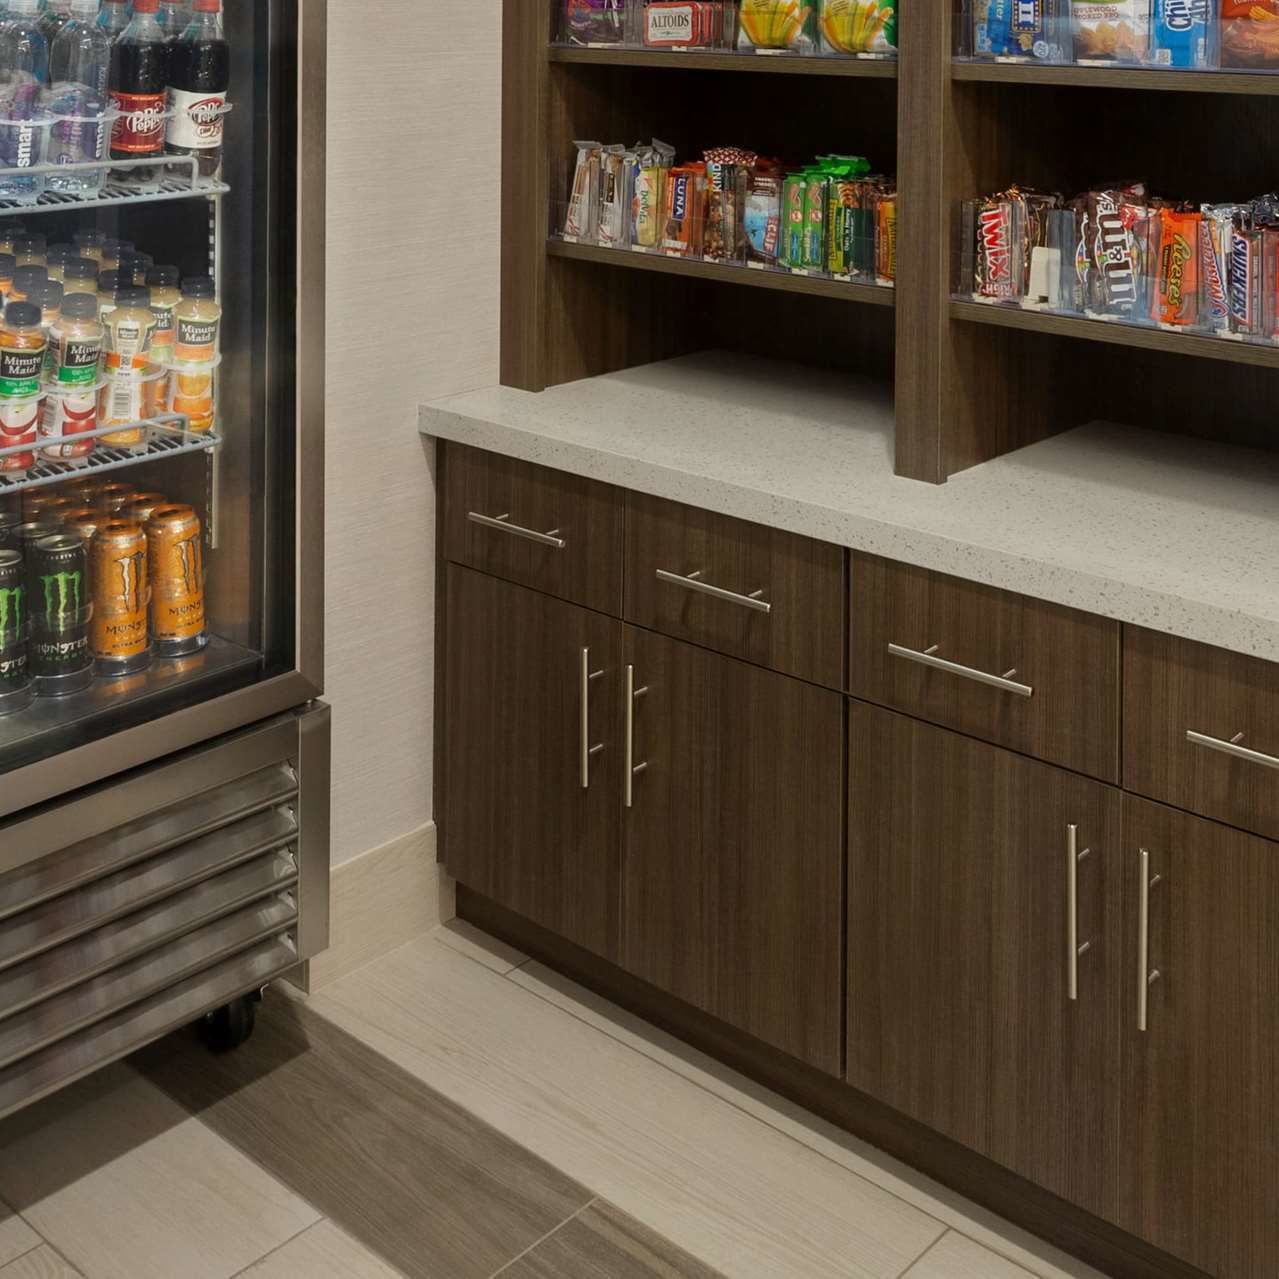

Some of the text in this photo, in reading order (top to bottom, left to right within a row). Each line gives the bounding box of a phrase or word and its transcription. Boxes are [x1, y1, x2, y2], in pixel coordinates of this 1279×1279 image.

[650, 14, 689, 28] ALTOIDS
[1017, 1, 1034, 24] II
[17, 118, 33, 168] smart
[713, 164, 722, 192] KIND
[675, 176, 686, 216] LUNA
[980, 205, 1011, 283] TWIX
[1168, 234, 1191, 306] Reese's
[1232, 234, 1248, 322] SNICKERS
[182, 324, 215, 335] Minute
[185, 333, 211, 343] Maid
[4, 355, 41, 366] Minute
[8, 364, 36, 375] Maid
